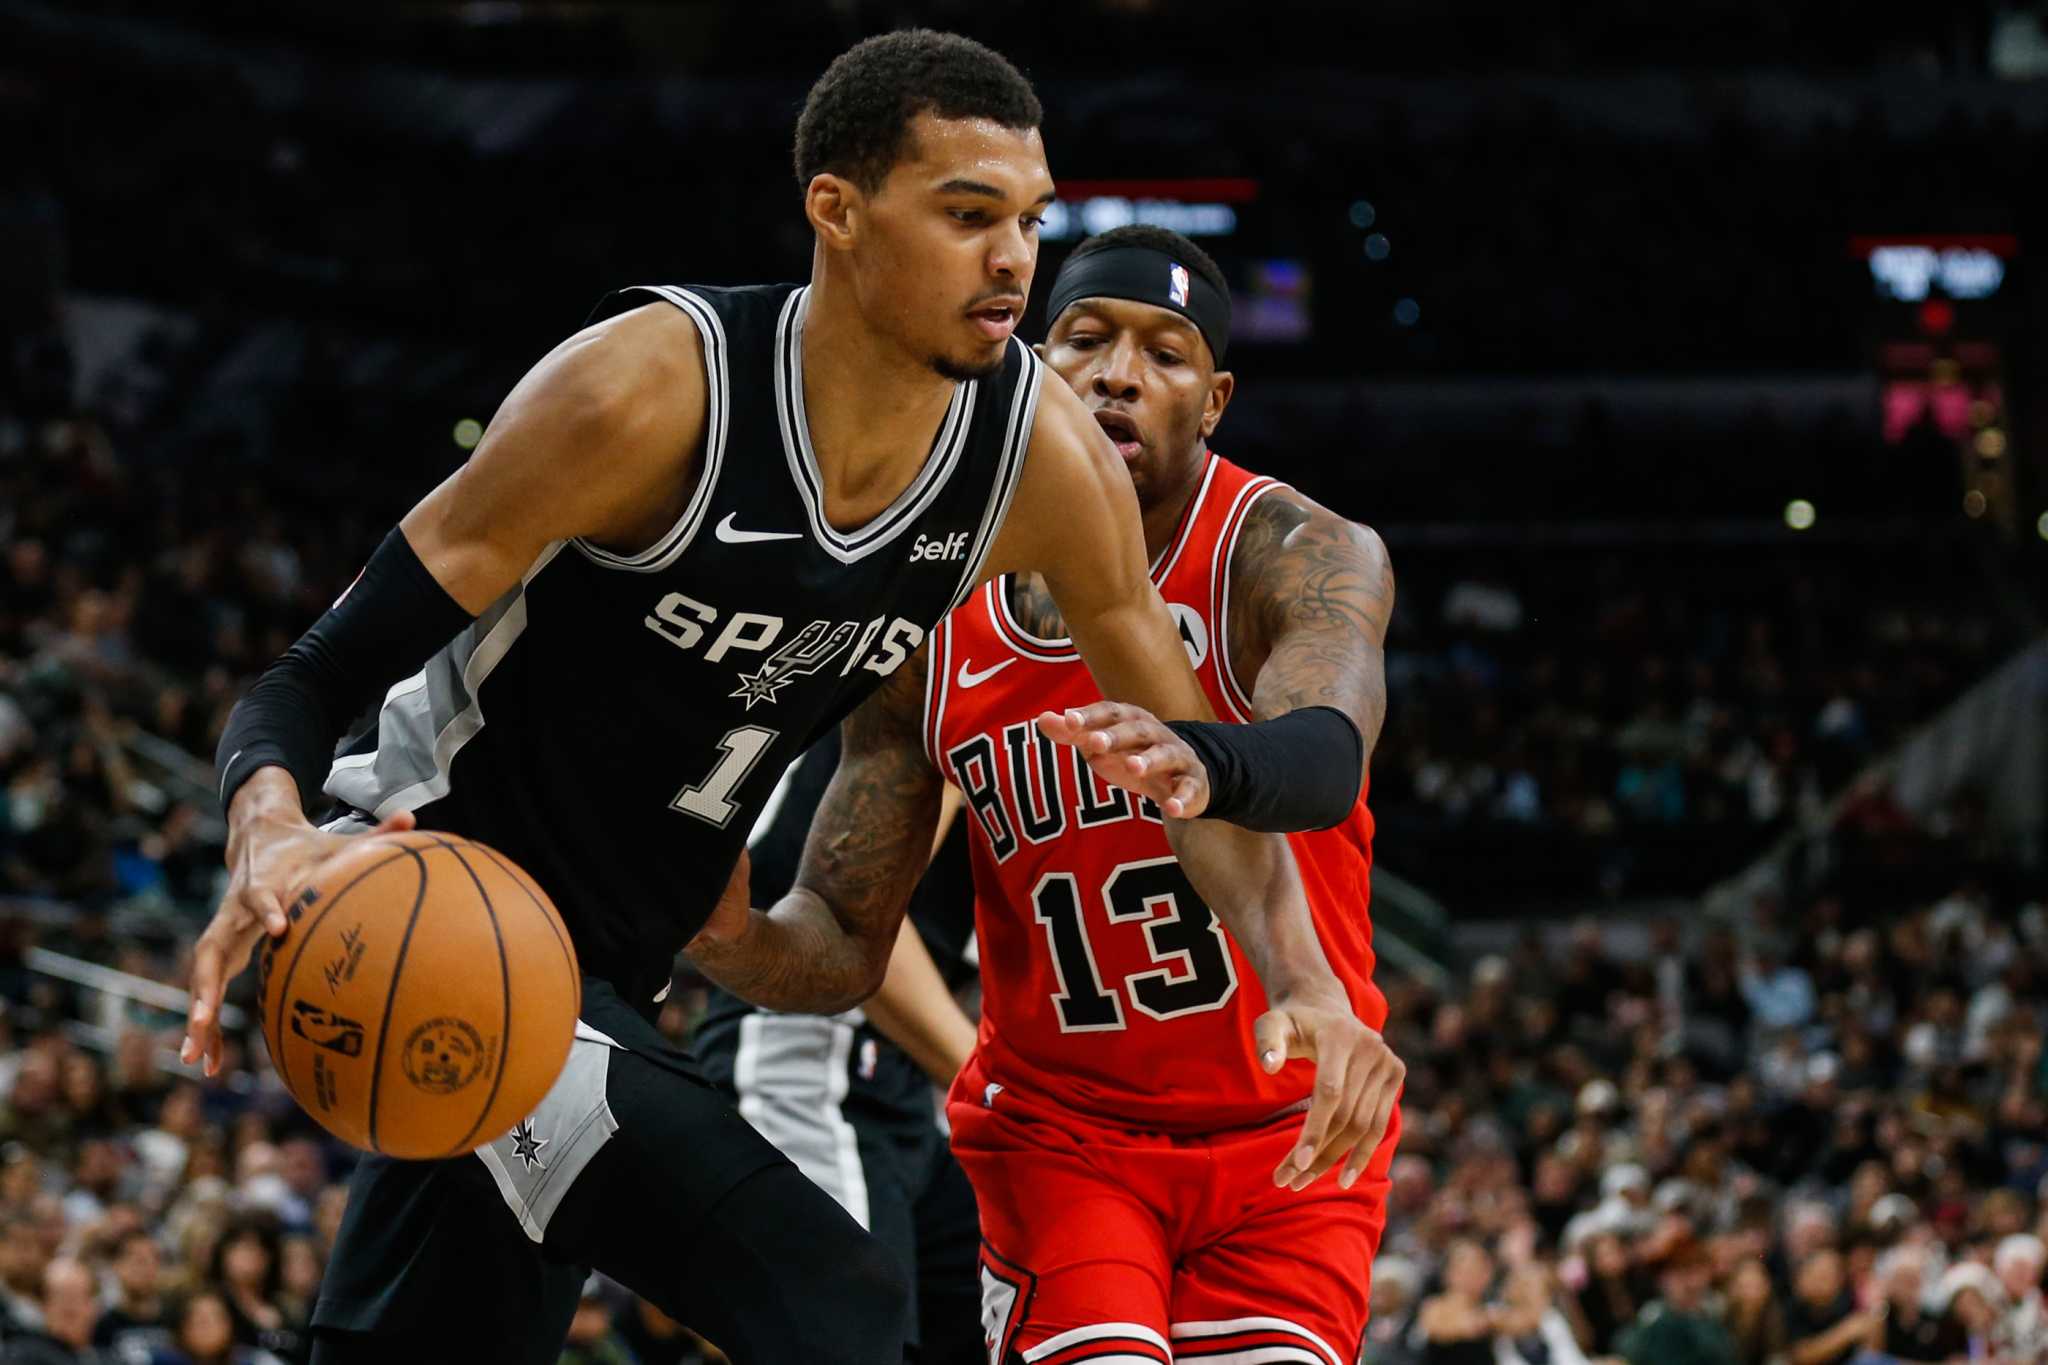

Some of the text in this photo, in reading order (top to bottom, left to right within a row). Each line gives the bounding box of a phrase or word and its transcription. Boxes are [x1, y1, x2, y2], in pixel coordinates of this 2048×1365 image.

[668, 724, 780, 830] 1
[946, 717, 1164, 865] BUL
[1031, 856, 1239, 1034] 13
